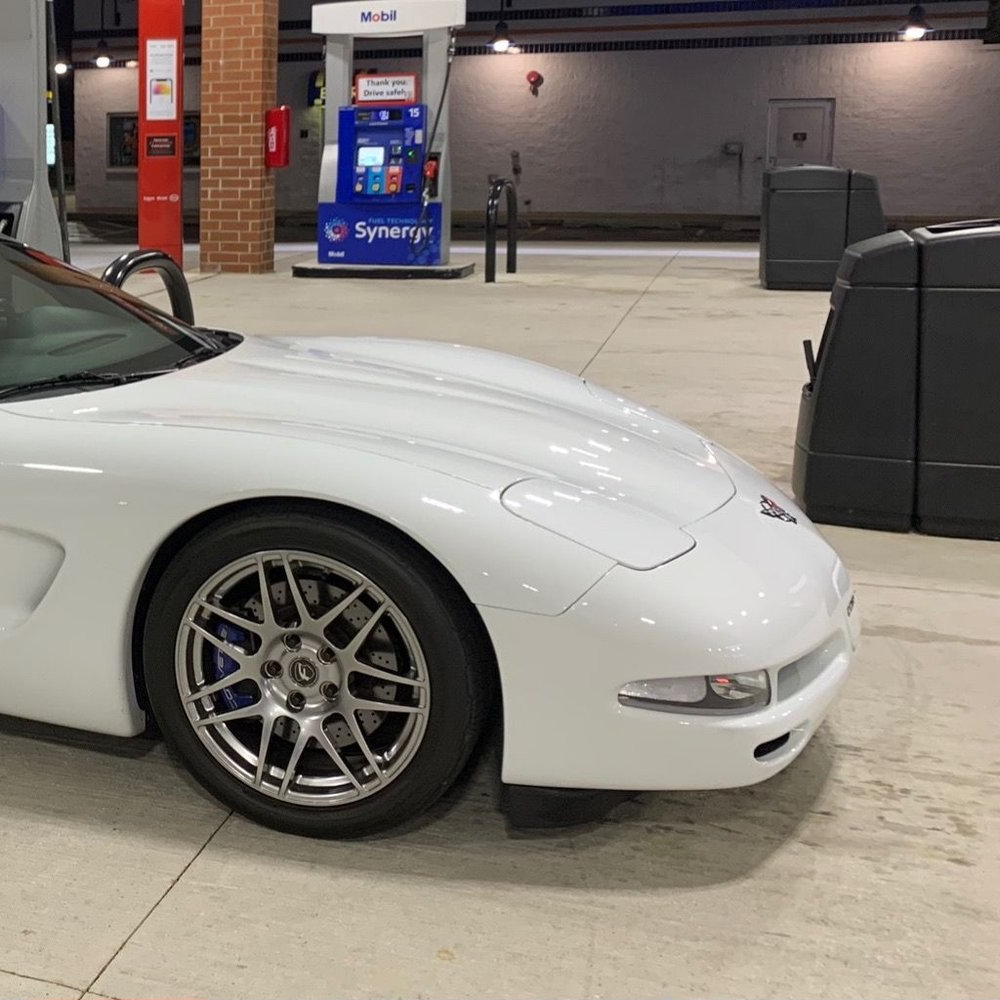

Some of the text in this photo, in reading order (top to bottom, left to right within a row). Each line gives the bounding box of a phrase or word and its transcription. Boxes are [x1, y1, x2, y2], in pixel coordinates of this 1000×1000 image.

[361, 10, 396, 22] Mobil
[363, 89, 384, 97] Drive
[408, 107, 420, 118] 15
[354, 221, 433, 243] Synergy
[328, 250, 345, 258] Mobil
